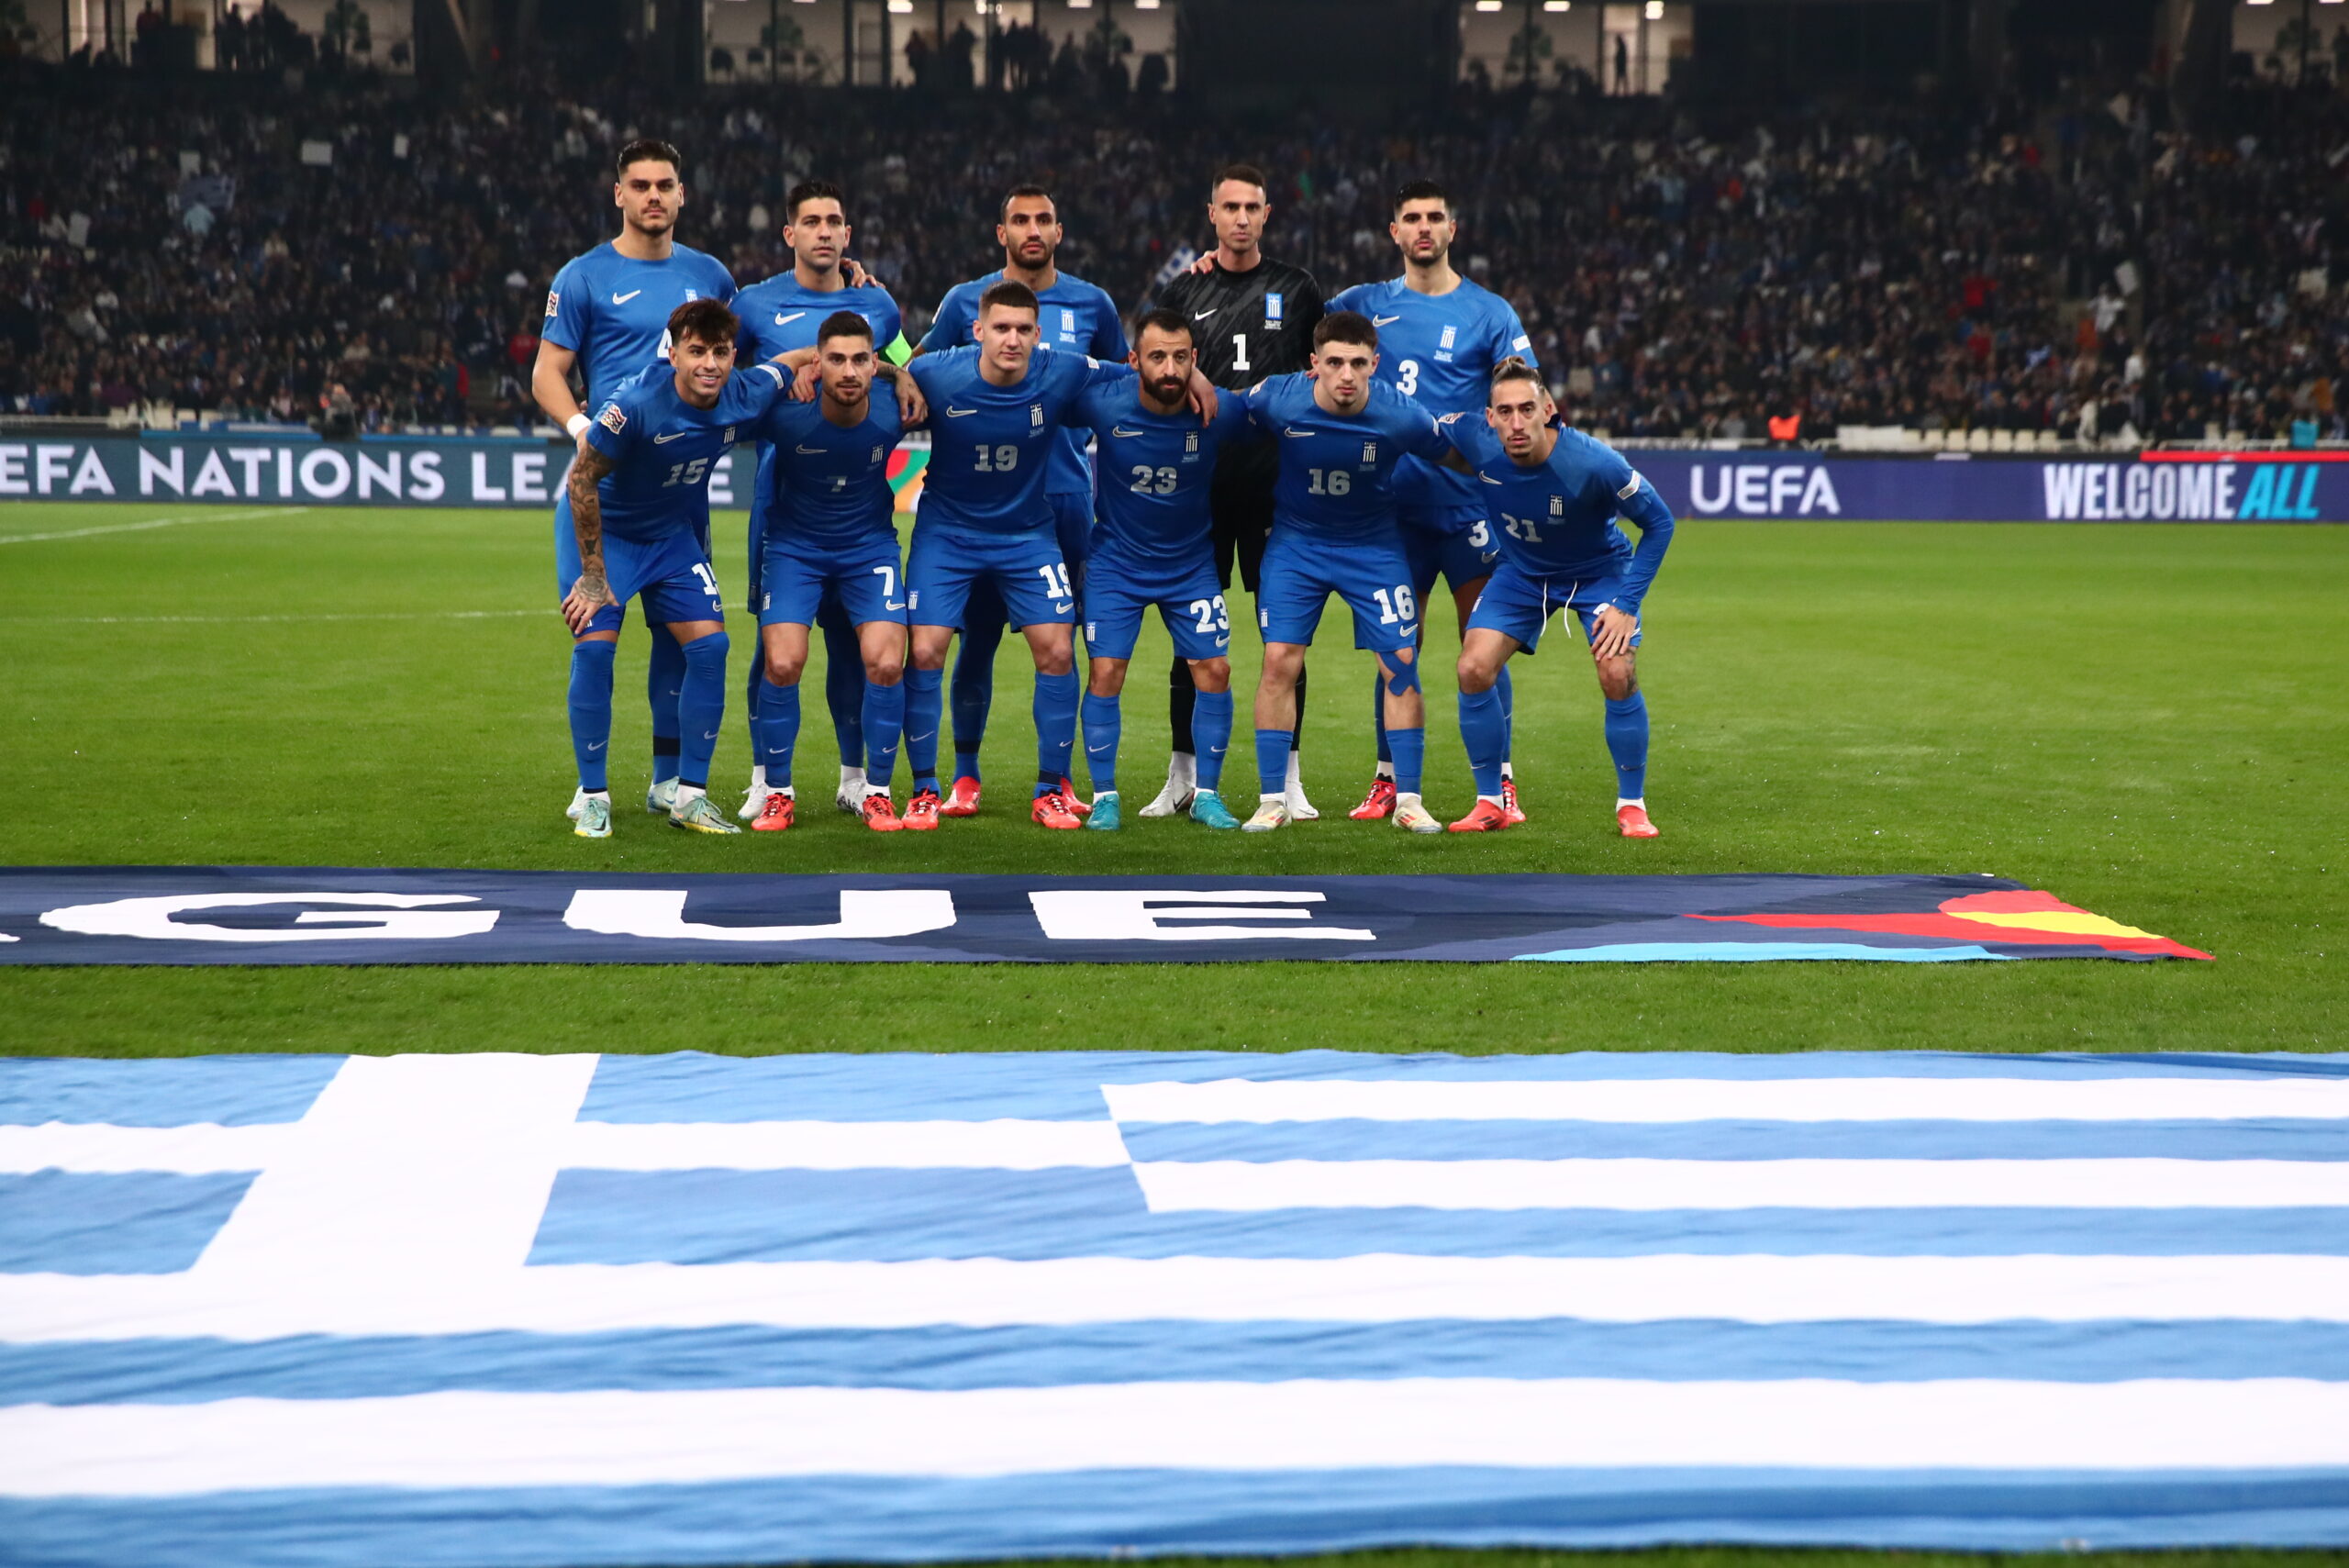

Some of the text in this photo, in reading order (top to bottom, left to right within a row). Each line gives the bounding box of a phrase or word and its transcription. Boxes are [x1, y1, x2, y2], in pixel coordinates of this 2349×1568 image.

[657, 328, 673, 358] 4
[1232, 333, 1251, 371] 1
[1396, 359, 1419, 395] 3
[0, 443, 117, 495] EFA
[139, 445, 446, 502] NATIONS
[662, 458, 708, 488] 15
[974, 444, 1019, 473] 19
[1130, 464, 1177, 494] 23
[1308, 467, 1351, 495] 16
[1690, 464, 1841, 515] UEFA
[2043, 463, 2320, 519] WELCOME ALL
[1467, 520, 1489, 548] 3
[1500, 512, 1543, 543] 21
[873, 566, 895, 596] 7
[1038, 562, 1073, 598] 19
[1190, 595, 1230, 633] 23
[1374, 584, 1416, 626] 16
[0, 890, 1375, 940] GUE
